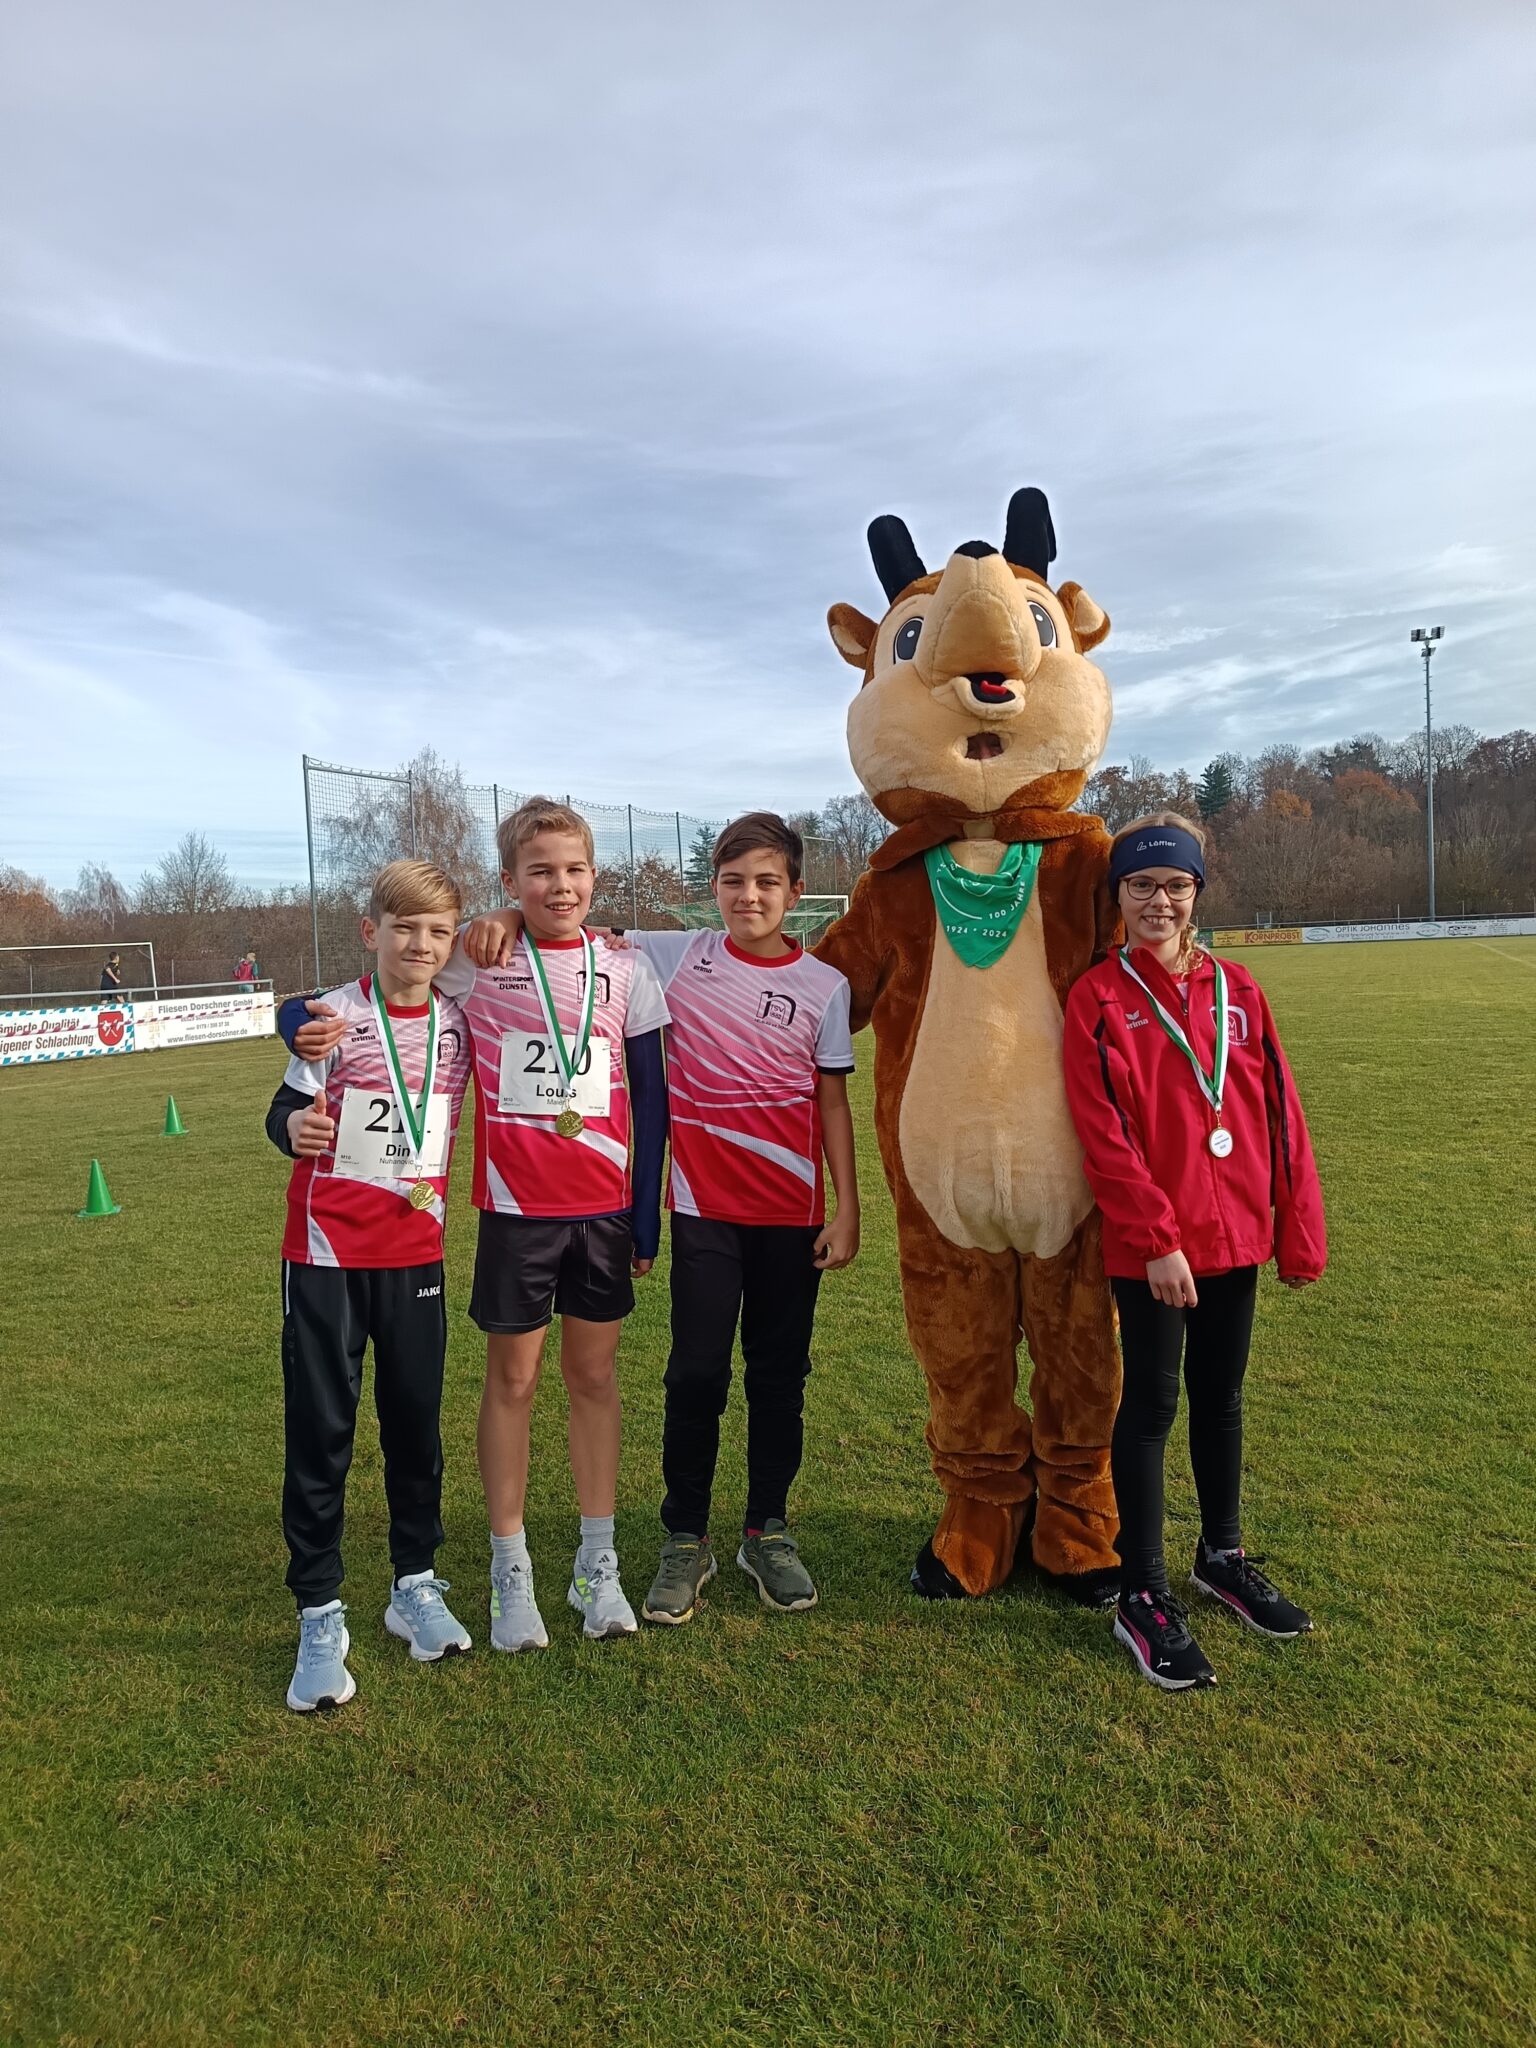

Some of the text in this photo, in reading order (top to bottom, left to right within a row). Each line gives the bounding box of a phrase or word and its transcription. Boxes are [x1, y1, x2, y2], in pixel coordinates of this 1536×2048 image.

[988, 881, 1026, 920] 100 JAHRE
[946, 925, 1007, 938] 1924 2024
[1244, 931, 1300, 944] KORNPROBST
[693, 964, 713, 974] erima
[158, 998, 253, 1014] Fliesen Dorschner GmbH
[771, 1004, 786, 1013] TSV
[1125, 1017, 1149, 1030] erima
[35, 1033, 95, 1050] Schlachtung
[167, 1028, 248, 1043] www.fliesen-dorschner.de
[351, 1034, 376, 1042] erima
[441, 1043, 454, 1051] TSV
[536, 1084, 577, 1098] Lous
[385, 1144, 411, 1157] Din
